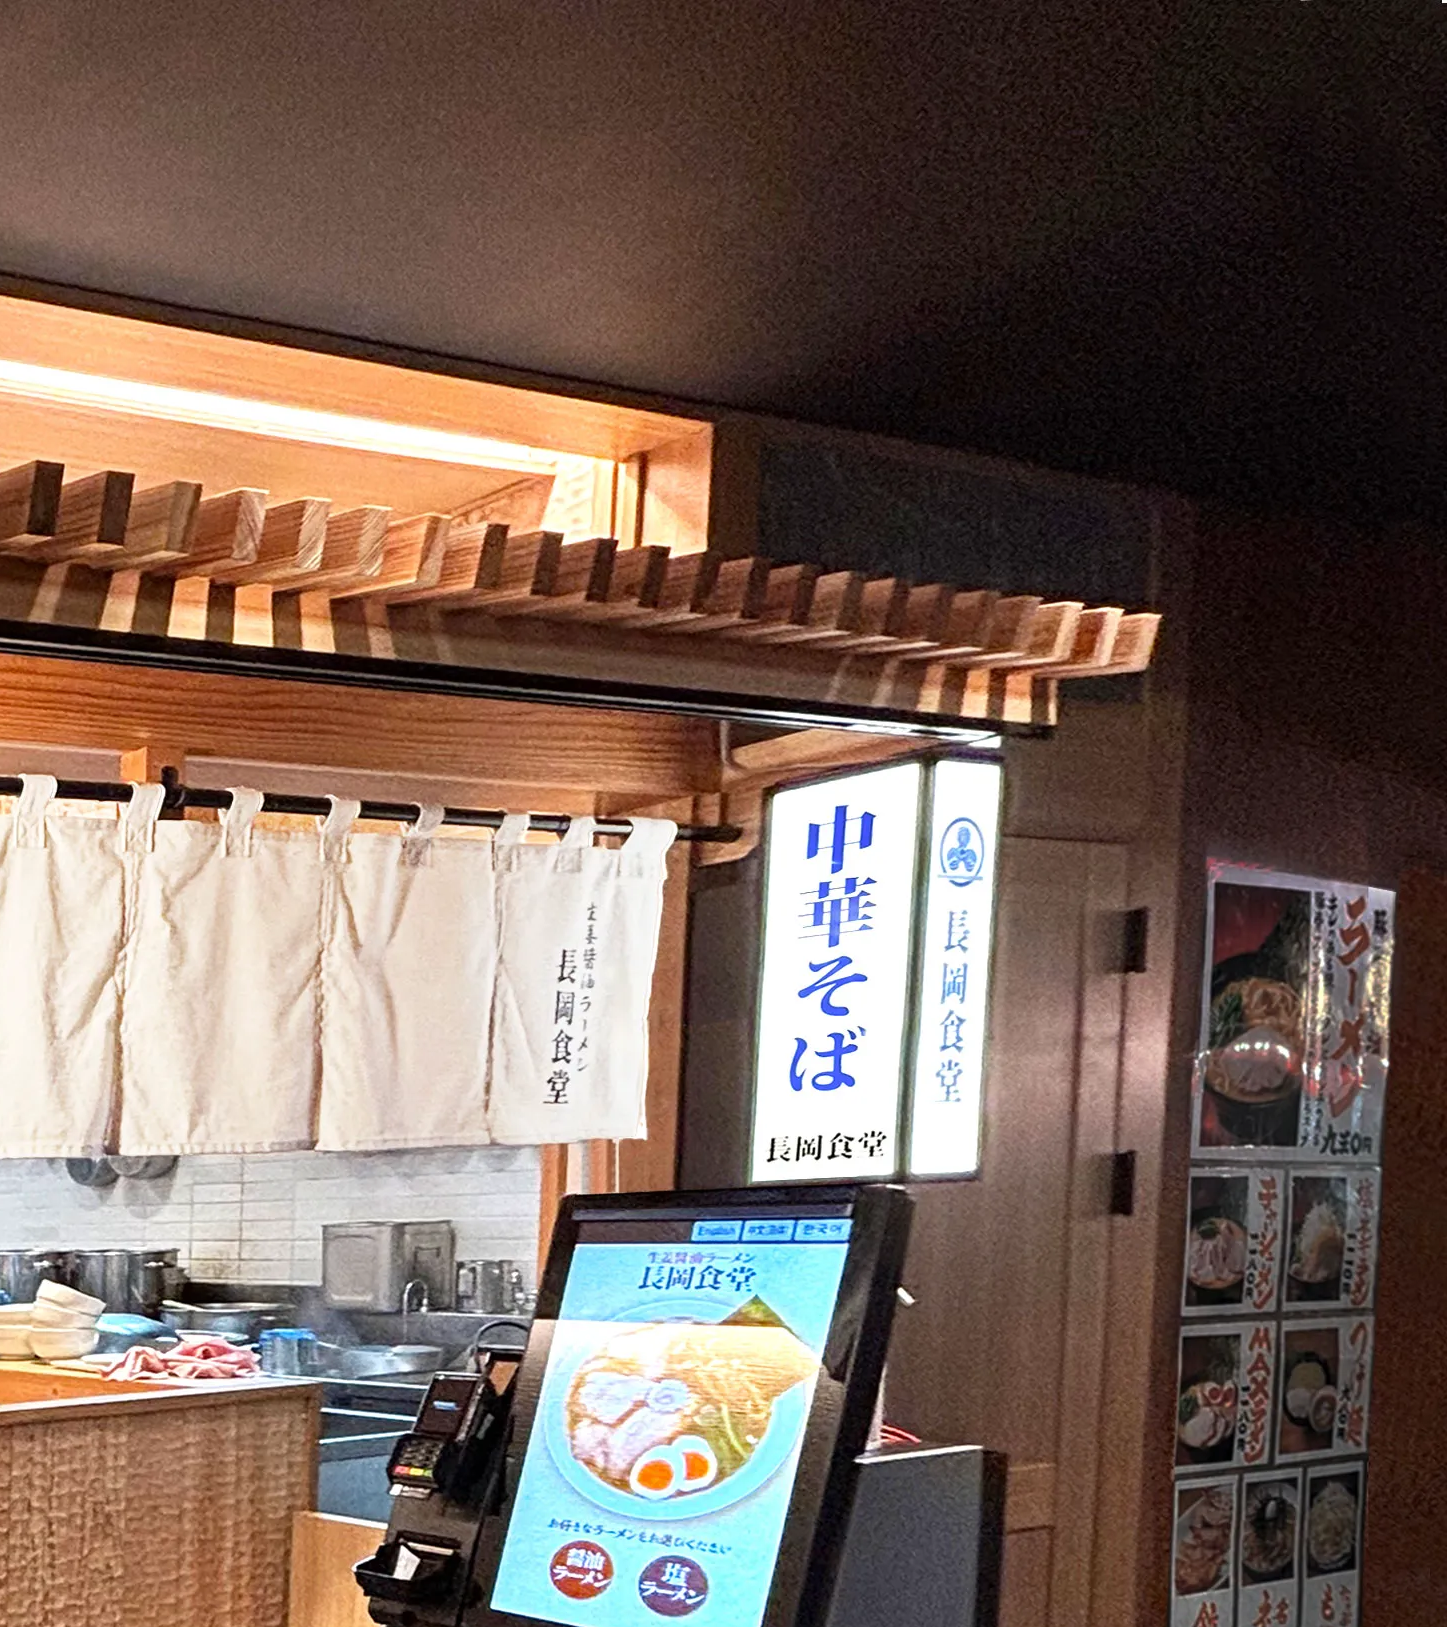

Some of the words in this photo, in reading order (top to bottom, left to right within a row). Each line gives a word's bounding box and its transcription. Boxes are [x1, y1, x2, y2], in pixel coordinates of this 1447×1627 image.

[789, 805, 877, 1091] 中華そば
[935, 910, 968, 1102] 長岡食堂
[1329, 896, 1370, 1118] ラーメン
[543, 949, 577, 1104] 長岡食堂
[766, 1131, 887, 1163] 長岡食堂
[638, 1265, 757, 1292] 長岡食堂
[547, 1517, 733, 1555] お好きなラーメンをお選びください
[565, 1547, 606, 1571] 醤油
[661, 1562, 691, 1587] 塩
[553, 1565, 612, 1588] ラーメン
[640, 1580, 706, 1605] ラーメン
